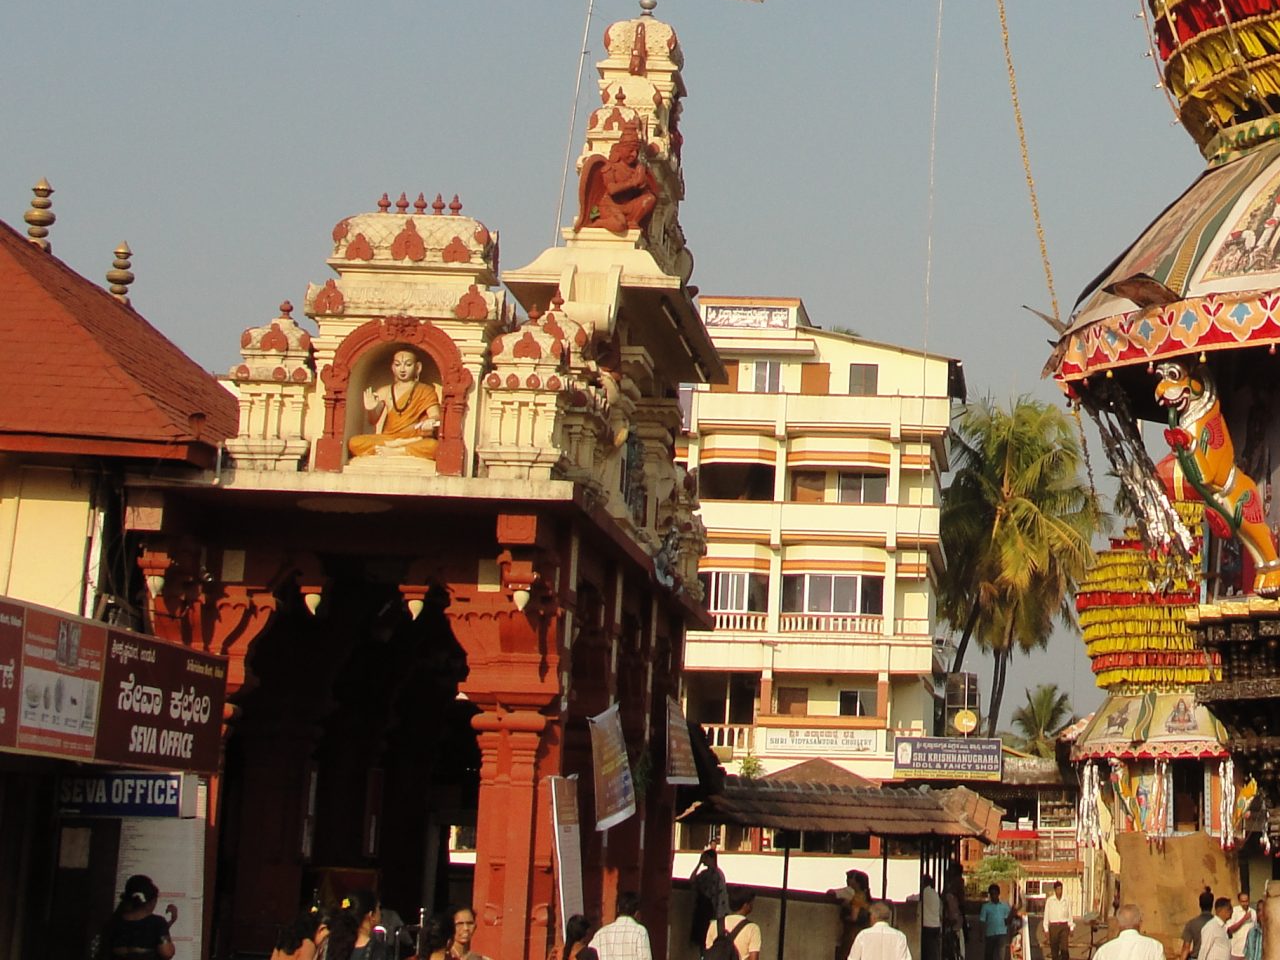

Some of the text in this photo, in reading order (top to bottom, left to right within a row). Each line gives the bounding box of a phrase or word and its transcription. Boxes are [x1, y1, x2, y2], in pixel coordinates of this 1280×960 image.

[118, 673, 211, 727] ಸೇವಾ ಕಛೇರಿ
[128, 725, 158, 754] SEVA
[159, 729, 194, 759] OFFICE
[912, 752, 999, 764] SRI KRISHNANUGRAHA
[943, 762, 973, 770] FANCY
[975, 763, 999, 771] SHOP
[60, 778, 179, 805] SEVA OFFICE
